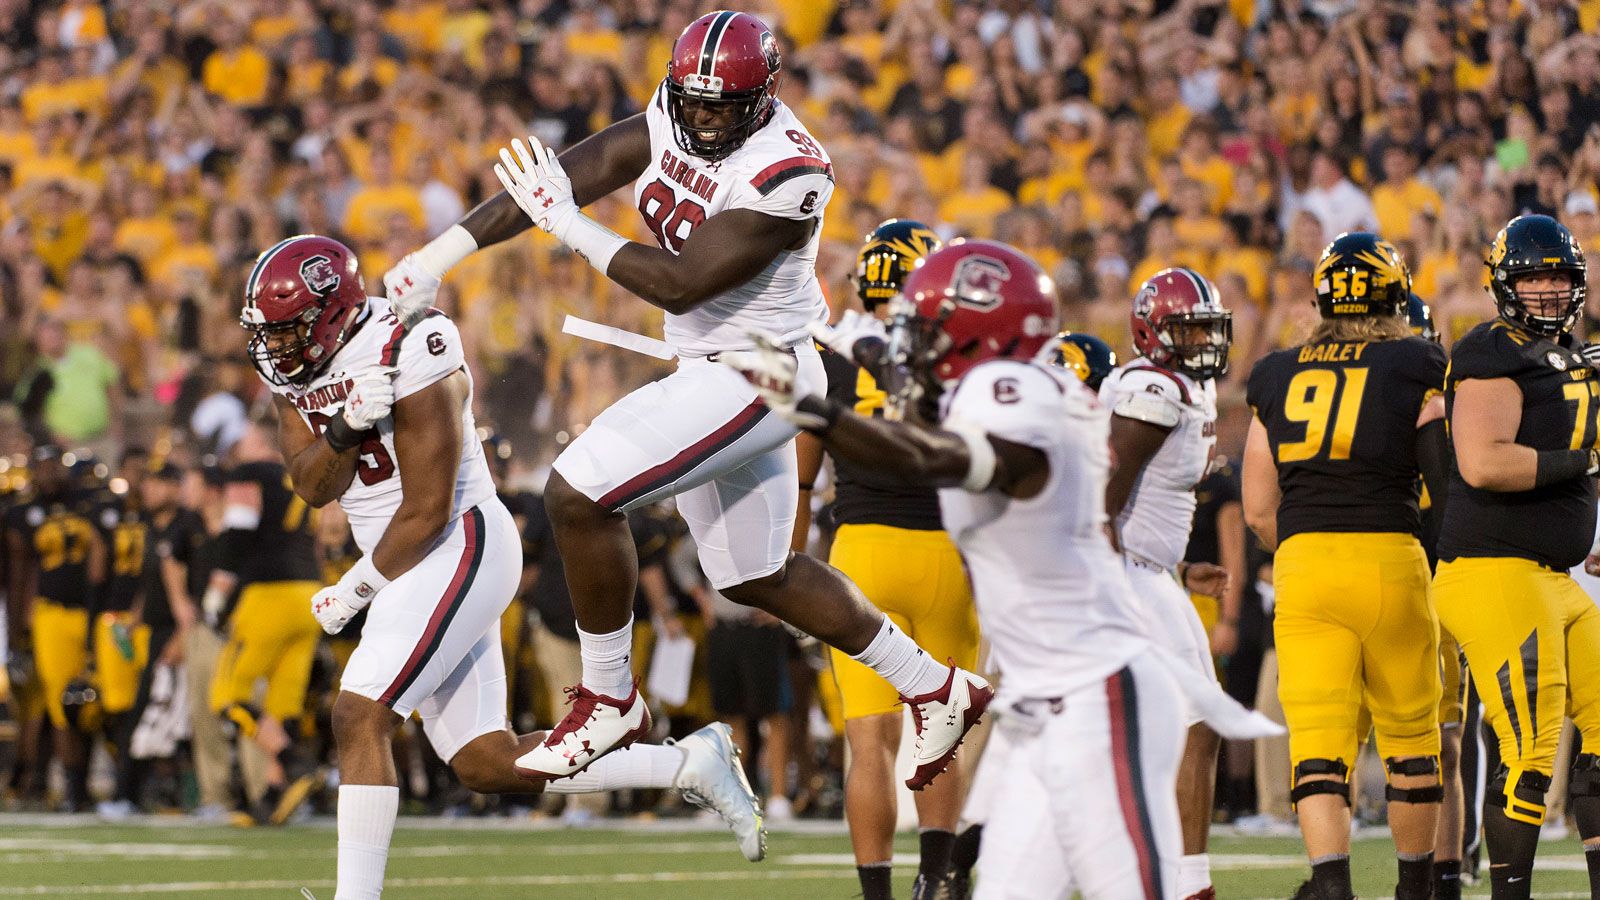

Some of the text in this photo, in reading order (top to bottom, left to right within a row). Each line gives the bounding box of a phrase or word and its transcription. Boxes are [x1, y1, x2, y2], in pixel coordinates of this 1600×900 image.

[785, 129, 823, 158] 99
[866, 253, 892, 282] 81
[1332, 270, 1369, 299] 56
[1333, 303, 1369, 314] MIZZOU
[1298, 341, 1369, 363] BAILEY
[1278, 367, 1370, 463] 91
